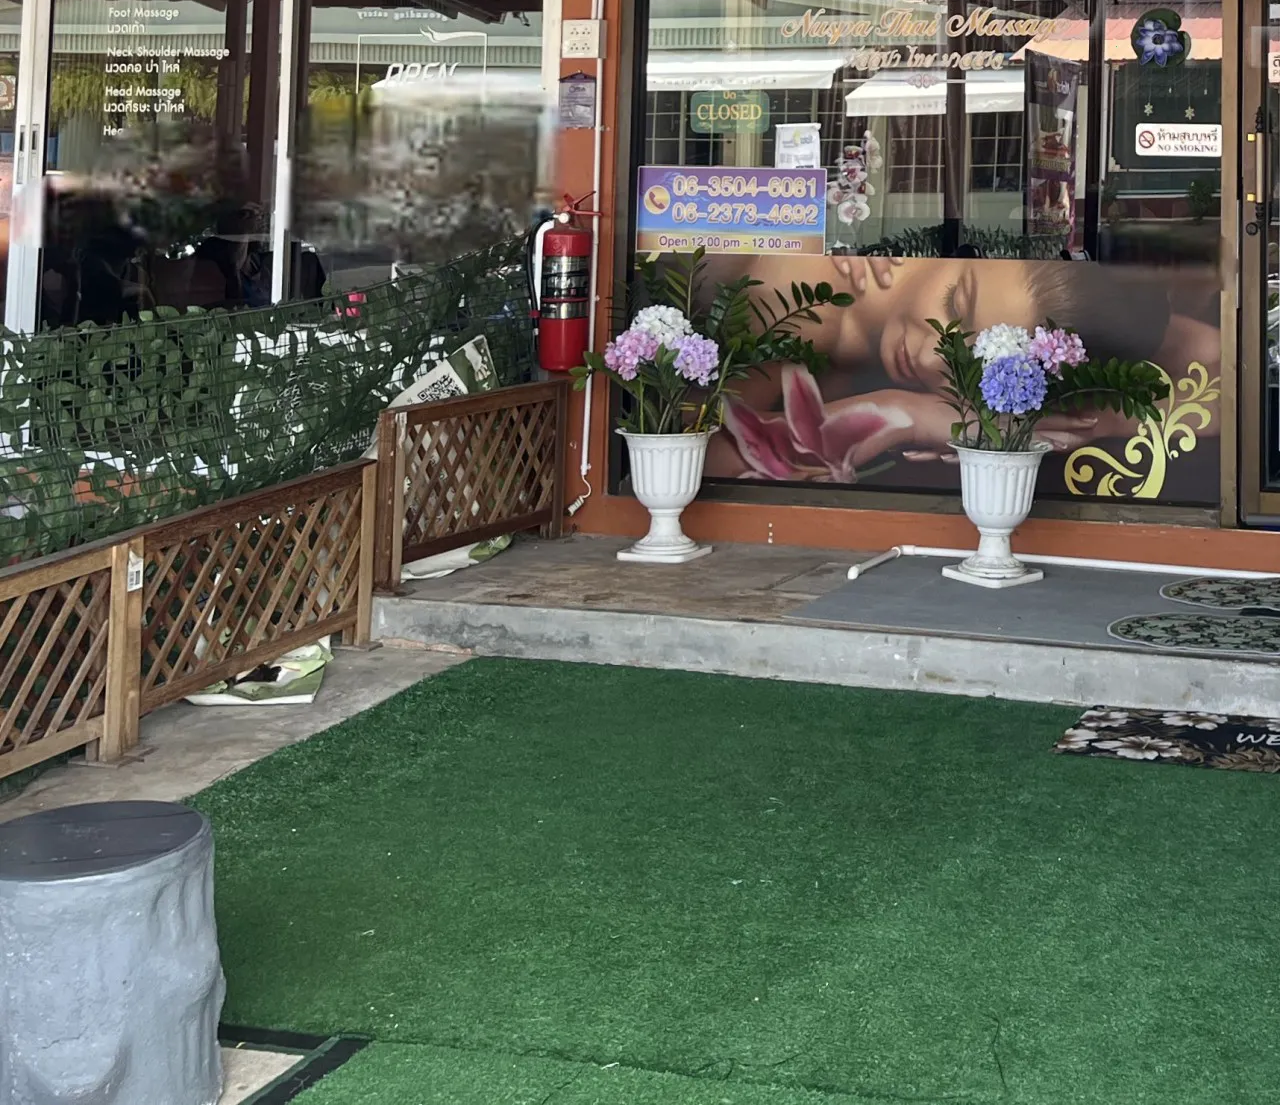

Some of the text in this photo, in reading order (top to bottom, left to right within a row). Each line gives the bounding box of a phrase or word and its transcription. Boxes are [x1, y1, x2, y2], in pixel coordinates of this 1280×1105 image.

[108, 7, 180, 21] Foot Massage
[780, 6, 1072, 44] Nuspa Thai Massage
[107, 45, 230, 60] Neck Shoulder Massage
[105, 85, 181, 99] Head Massage
[696, 103, 762, 121] CLOSED
[1158, 144, 1218, 153] NO SMOKING
[672, 175, 818, 199] 06-3504-6081
[671, 201, 819, 226] 06-2373-4692
[658, 236, 688, 251] Open
[723, 240, 740, 252] pm
[785, 241, 802, 249] am
